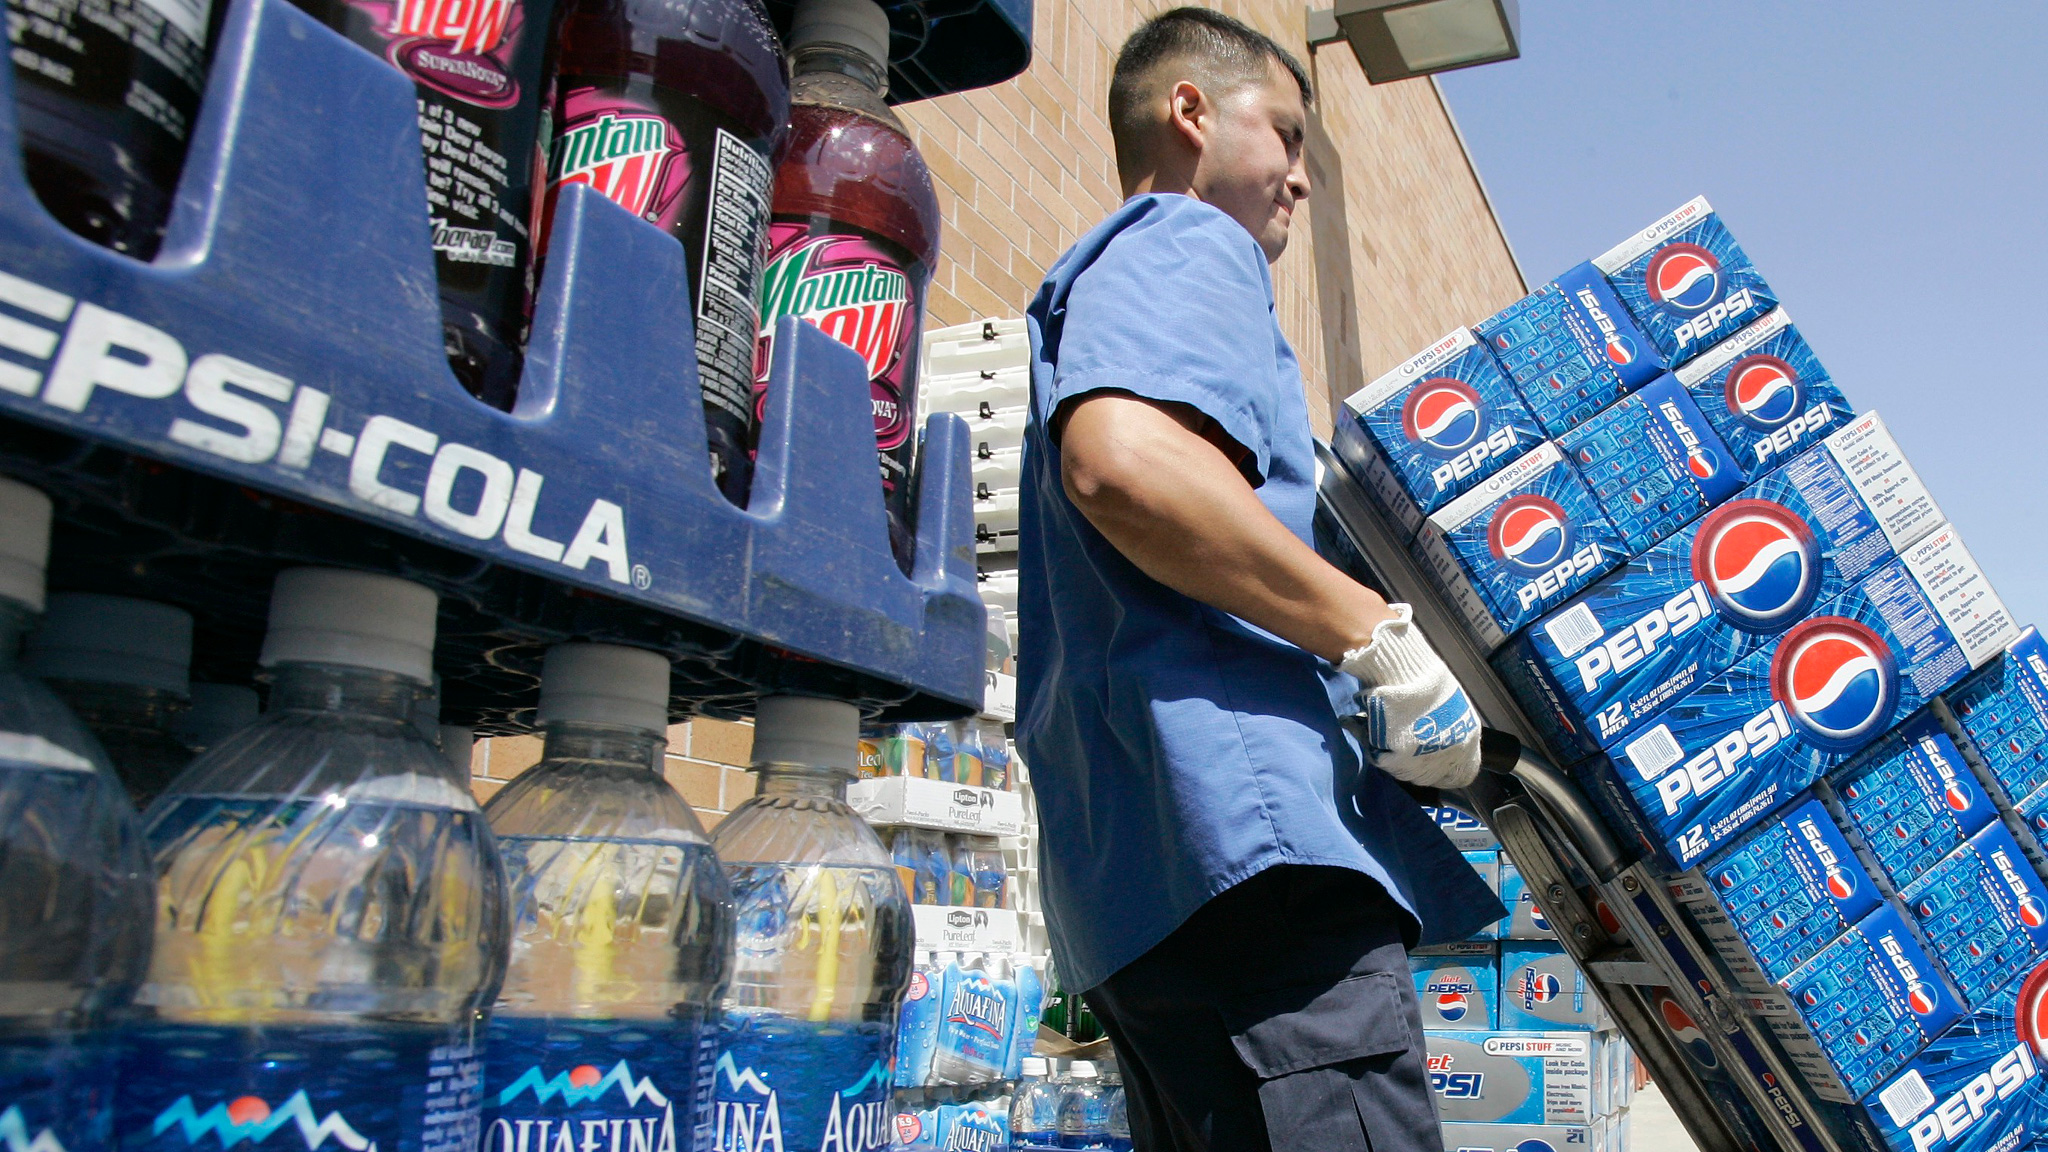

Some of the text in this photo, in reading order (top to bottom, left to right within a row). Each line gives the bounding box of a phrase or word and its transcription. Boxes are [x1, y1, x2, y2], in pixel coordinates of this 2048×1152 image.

[443, 109, 454, 124] 3
[441, 140, 469, 163] Dew
[444, 125, 473, 148] Dew
[455, 181, 476, 205] Try
[1655, 217, 1677, 233] PEPSI
[1674, 205, 1697, 221] STUFF
[761, 239, 908, 332] Mountain
[1576, 288, 1619, 342] PEPSI
[1674, 288, 1754, 349] PEPSI
[1413, 350, 1437, 368] PEPSI
[1434, 336, 1458, 355] STUFF
[1734, 327, 1756, 345] PEPSI
[0, 273, 631, 585] EPSI-COLA
[1658, 402, 1703, 457] PEPSI
[1753, 401, 1833, 464] PEPSI
[1841, 429, 1858, 443] PEPSI
[1431, 425, 1519, 492] PEPSI
[1499, 466, 1522, 486] PEPSI
[1520, 452, 1544, 471] STUFF
[1916, 543, 1934, 557] PEPSI
[1516, 542, 1606, 612] PEPSI
[1574, 581, 1713, 693] PEPSI
[1413, 709, 1478, 757] PEPSI
[1596, 701, 1625, 731] 12
[1602, 717, 1630, 741] PACK
[1655, 701, 1791, 816] PEPSI
[1918, 735, 1957, 790] PEPSI
[954, 791, 977, 803] Lipton
[1676, 824, 1705, 854] 12
[1682, 839, 1710, 863] PACK
[1798, 818, 1841, 876] PEPSI
[1990, 850, 2031, 906] PEPSI
[948, 912, 972, 925] Lipton
[1440, 974, 1461, 983] diet
[1878, 935, 1923, 993] PEPSI
[1428, 983, 1473, 993] PEPSI
[1524, 967, 1536, 1011] PEPSI
[947, 982, 1006, 1038] AQUAFINA
[1500, 1042, 1552, 1051] PEPSI STUFF
[1768, 1086, 1802, 1128] PEPSI
[1907, 1041, 2036, 1152] PEPSI
